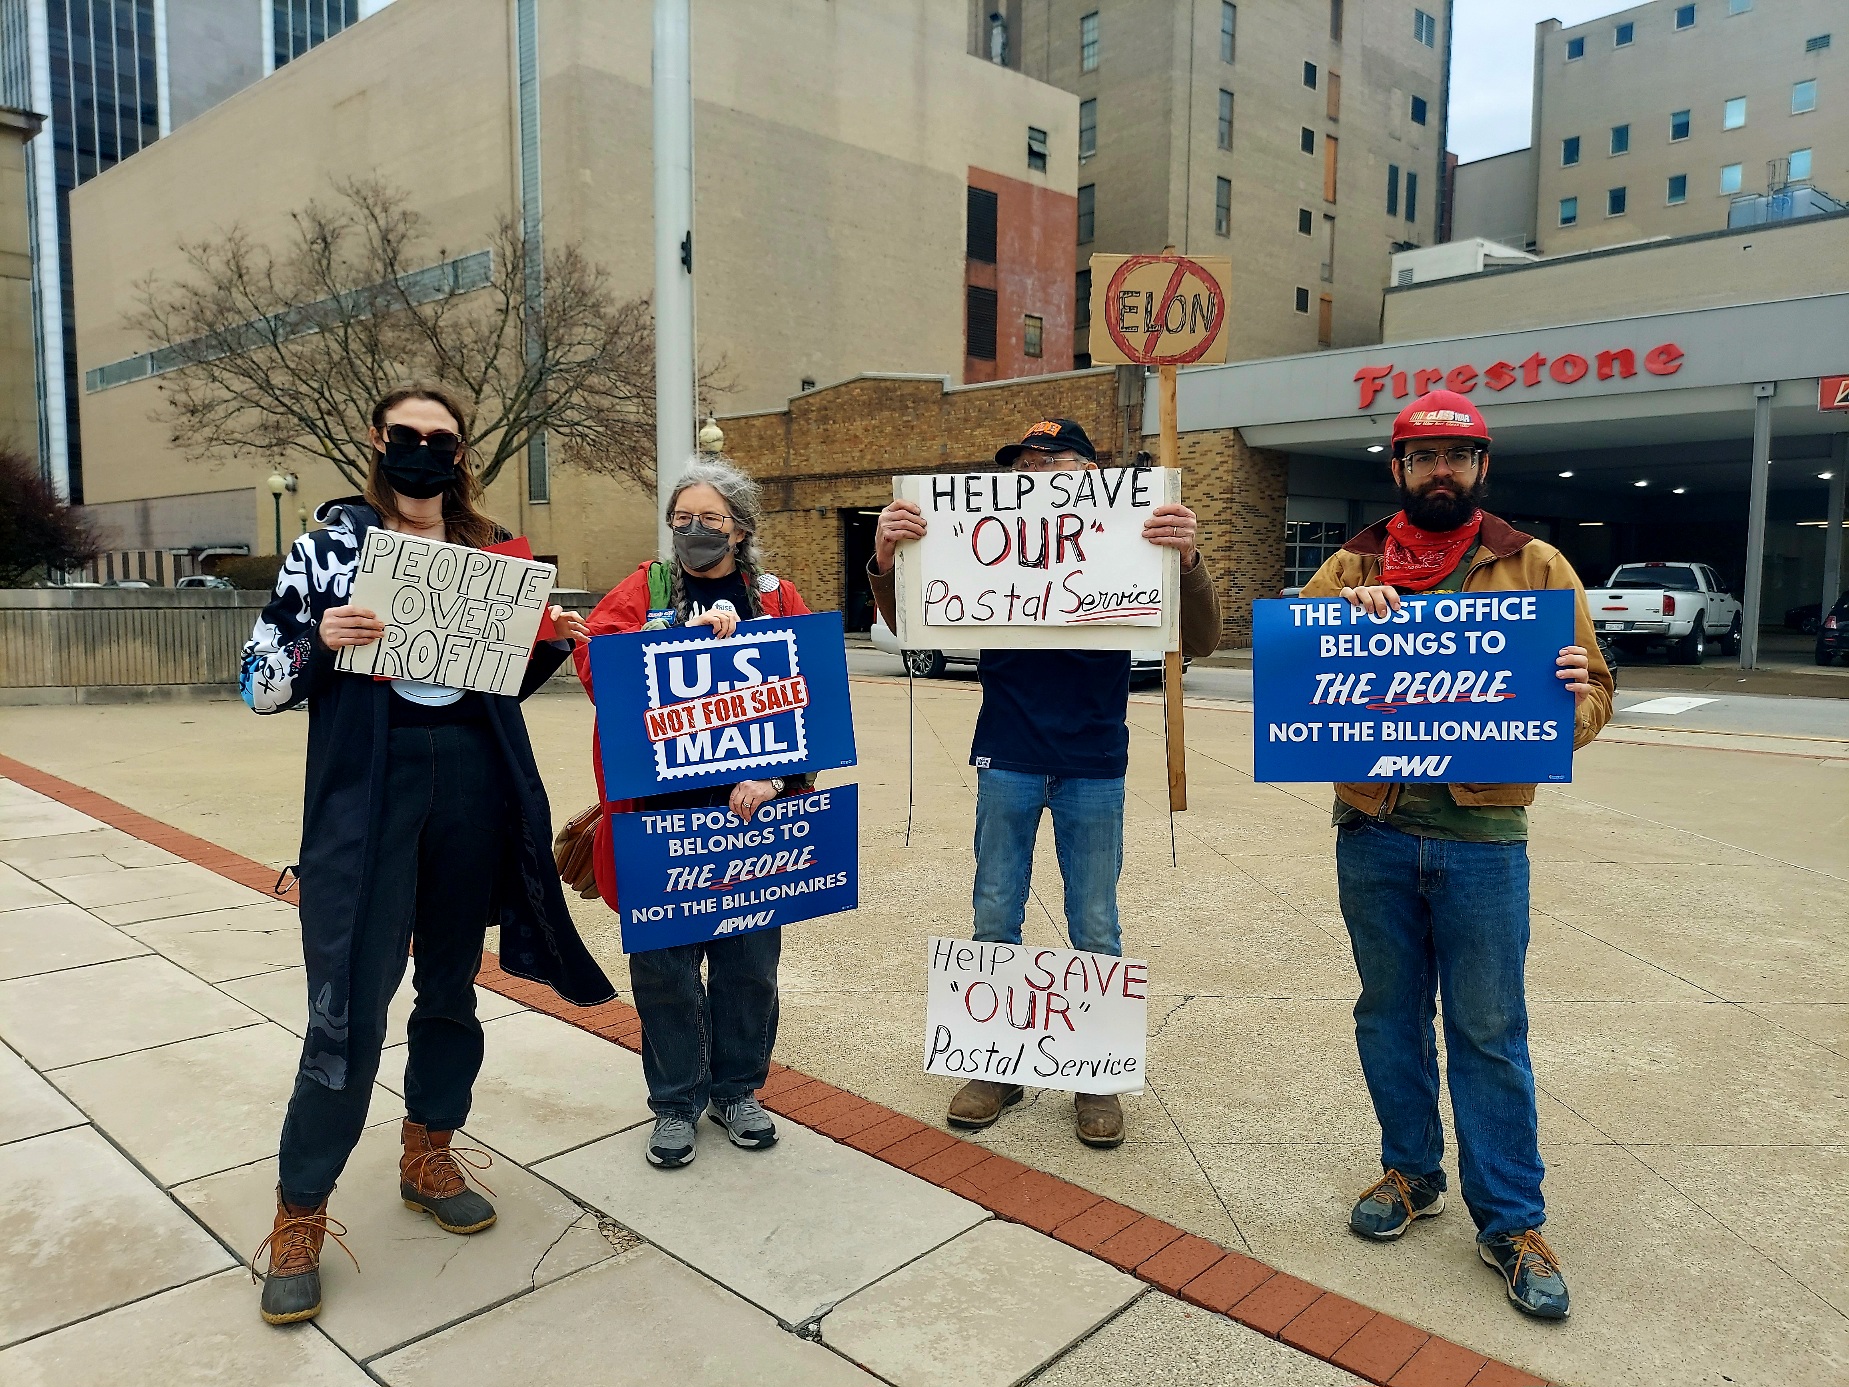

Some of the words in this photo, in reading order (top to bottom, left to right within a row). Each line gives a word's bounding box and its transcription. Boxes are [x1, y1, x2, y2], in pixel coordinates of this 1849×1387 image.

[1118, 290, 1216, 335] ELON
[1352, 342, 1685, 410] Firestone
[932, 474, 1035, 513] HELP
[1049, 467, 1151, 508] SAVE
[361, 532, 552, 610] PEOPLE
[391, 584, 514, 642] OVER
[924, 579, 1053, 626] Postal
[1058, 569, 1162, 613] Service
[1289, 603, 1342, 627] THE
[1434, 596, 1537, 623] OFFICE
[1319, 632, 1457, 658] BELONGS
[1464, 630, 1506, 655] TO
[668, 647, 780, 699] U.S.
[1311, 672, 1377, 706] THE
[1383, 669, 1513, 705] PEOPLE
[648, 705, 698, 738] NOT
[702, 697, 748, 726] FOR
[750, 680, 805, 714] SALE
[1269, 722, 1323, 742] NOT
[1328, 722, 1375, 742] THE
[1381, 720, 1558, 742] BILLIONAIRES
[676, 721, 788, 765] MAIL
[1367, 755, 1453, 777] APWU
[641, 813, 686, 835] THE
[691, 810, 749, 831] POS
[757, 793, 831, 822] OFFICE
[668, 827, 775, 857] BELONGS
[780, 821, 811, 841] TO
[666, 863, 716, 893] THE
[722, 845, 815, 884] PEOPLE
[631, 903, 676, 924] NOT
[680, 896, 718, 916] THE
[722, 871, 848, 910] BILLIONAIRES
[712, 909, 776, 936] APWU
[1024, 950, 1148, 1000] SAVE
[925, 1024, 1025, 1076] Postal
[1033, 1035, 1137, 1078] Service
